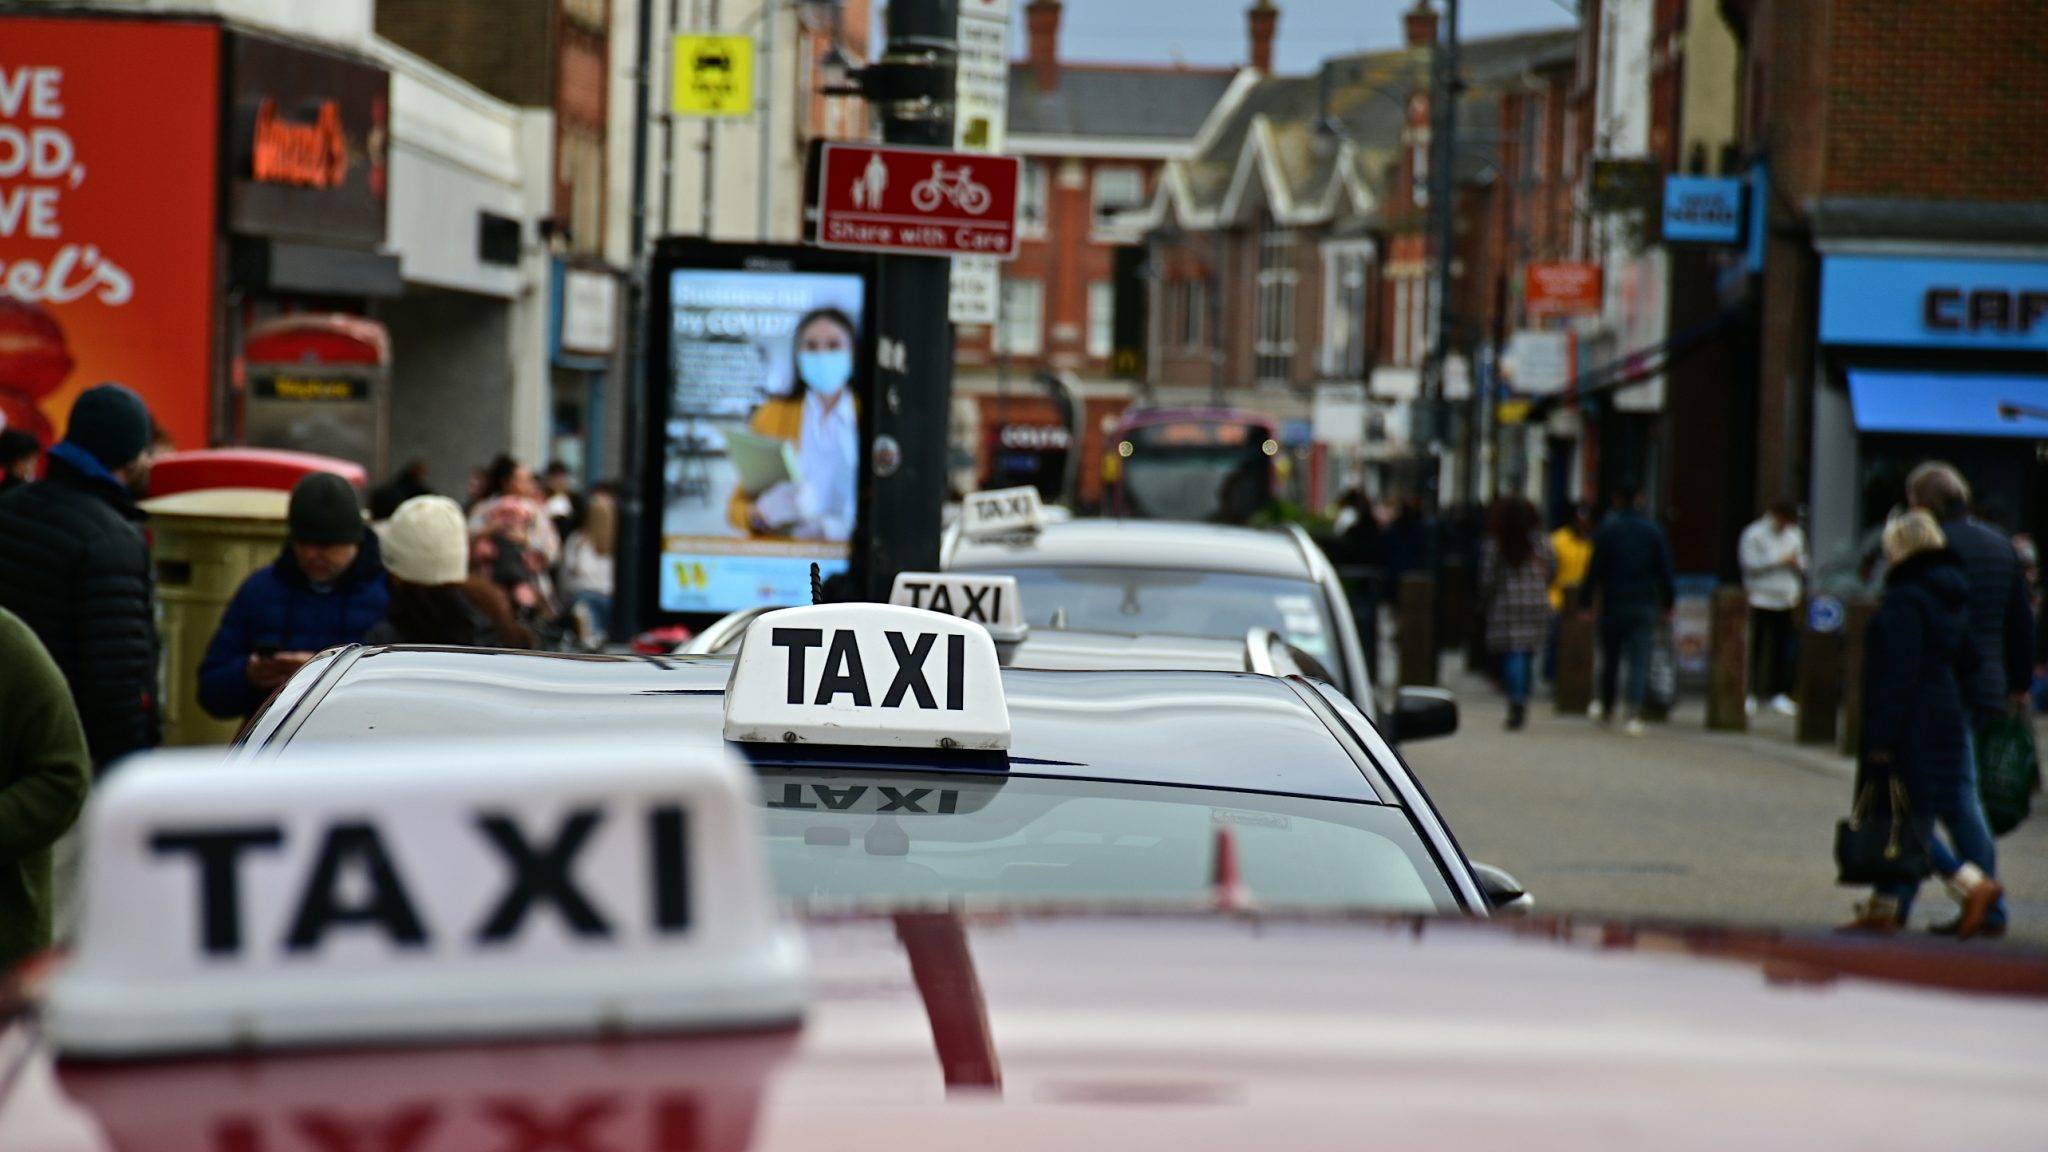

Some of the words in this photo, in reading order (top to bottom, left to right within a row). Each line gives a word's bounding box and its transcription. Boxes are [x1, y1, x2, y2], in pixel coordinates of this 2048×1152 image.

[0, 66, 65, 119] VE
[0, 126, 86, 191] OD,
[0, 185, 61, 238] VE
[829, 219, 891, 242] Share
[900, 226, 947, 245] with
[955, 227, 1008, 250] Care
[0, 243, 135, 306] el's
[976, 495, 1031, 520] TAXI
[903, 583, 1002, 624] TAXI
[772, 628, 965, 710] TAXI
[147, 806, 692, 955] TAXI
